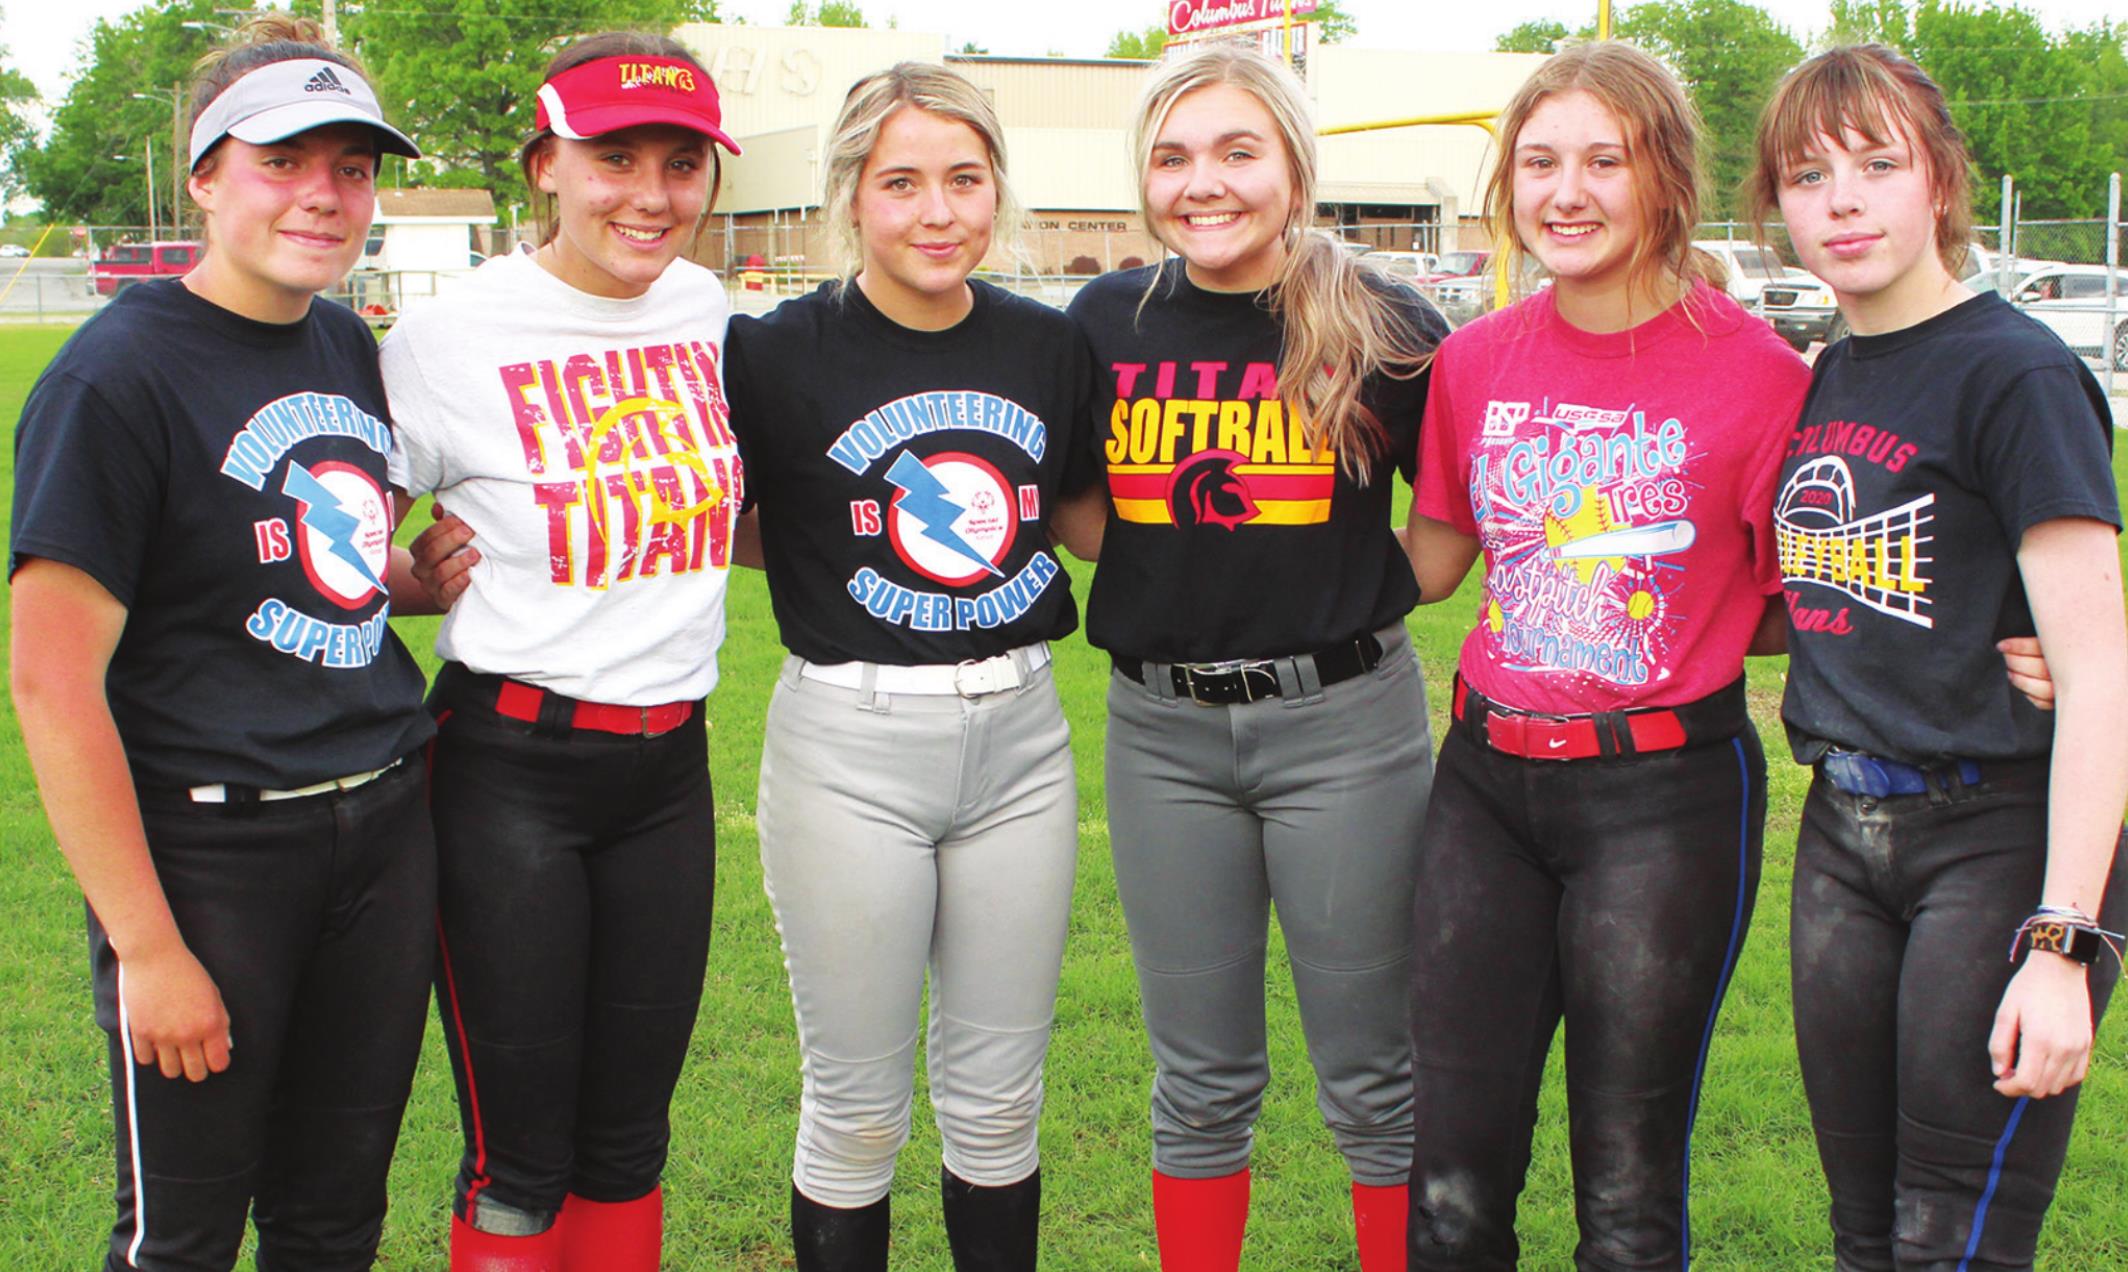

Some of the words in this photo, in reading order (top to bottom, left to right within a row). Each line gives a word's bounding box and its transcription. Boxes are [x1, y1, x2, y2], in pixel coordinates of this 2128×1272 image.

[1171, 0, 1255, 32] Columbus
[304, 82, 352, 96] adidas
[1067, 220, 1127, 232] CENTER
[1111, 361, 1283, 400] TITA
[826, 390, 1046, 476] VOLUNTEERING
[1105, 398, 1335, 464] SOFTBALL
[1504, 411, 1687, 518] Gigante
[850, 499, 882, 536] IS
[1018, 484, 1040, 522] M
[1598, 479, 1689, 524] Tres
[1800, 489, 1833, 505] 2020
[254, 518, 292, 564] IS
[846, 566, 952, 631] SUPER
[955, 551, 1059, 631] POWER
[246, 598, 366, 669] SUPER
[1503, 612, 1649, 685] Tournament
